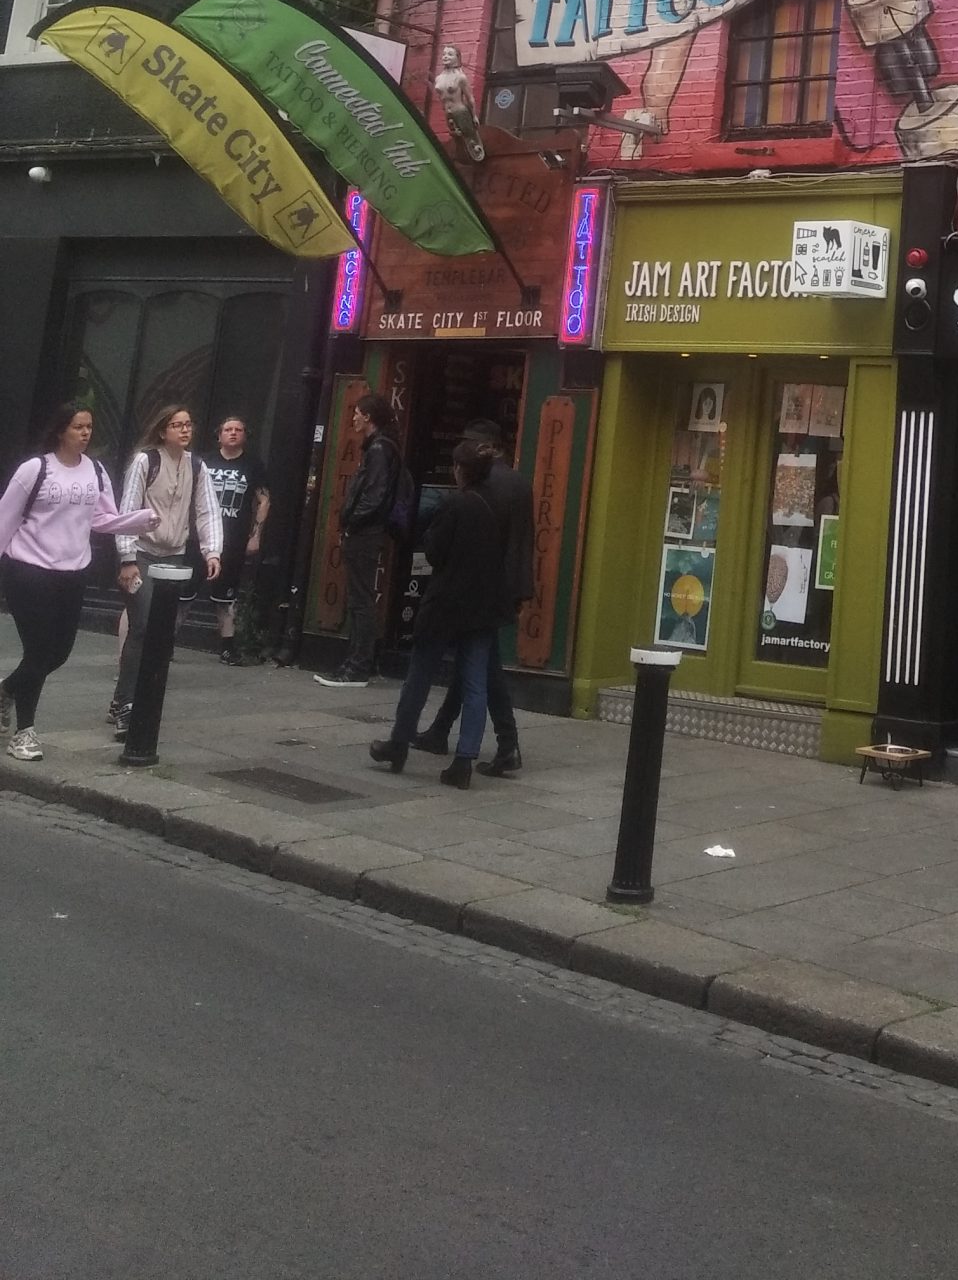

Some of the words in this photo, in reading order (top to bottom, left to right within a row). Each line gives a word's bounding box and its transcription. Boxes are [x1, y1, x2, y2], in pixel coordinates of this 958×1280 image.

[141, 45, 228, 136] Skate
[224, 129, 282, 204] City
[265, 51, 324, 113] TATTOO
[323, 112, 336, 128] &
[336, 125, 398, 200] PIERCING
[294, 40, 404, 138] Connected
[383, 140, 431, 178] Ink
[567, 194, 595, 334] TATTOO
[625, 261, 671, 297] JAM
[677, 261, 722, 298] ART
[726, 261, 808, 298] FACTO
[379, 312, 423, 330] SKATE
[433, 311, 464, 328] CITY
[496, 310, 542, 327] FLOOR
[625, 304, 656, 323] IRISH
[660, 304, 701, 323] DESIGN
[761, 634, 830, 652] jamartfactory
